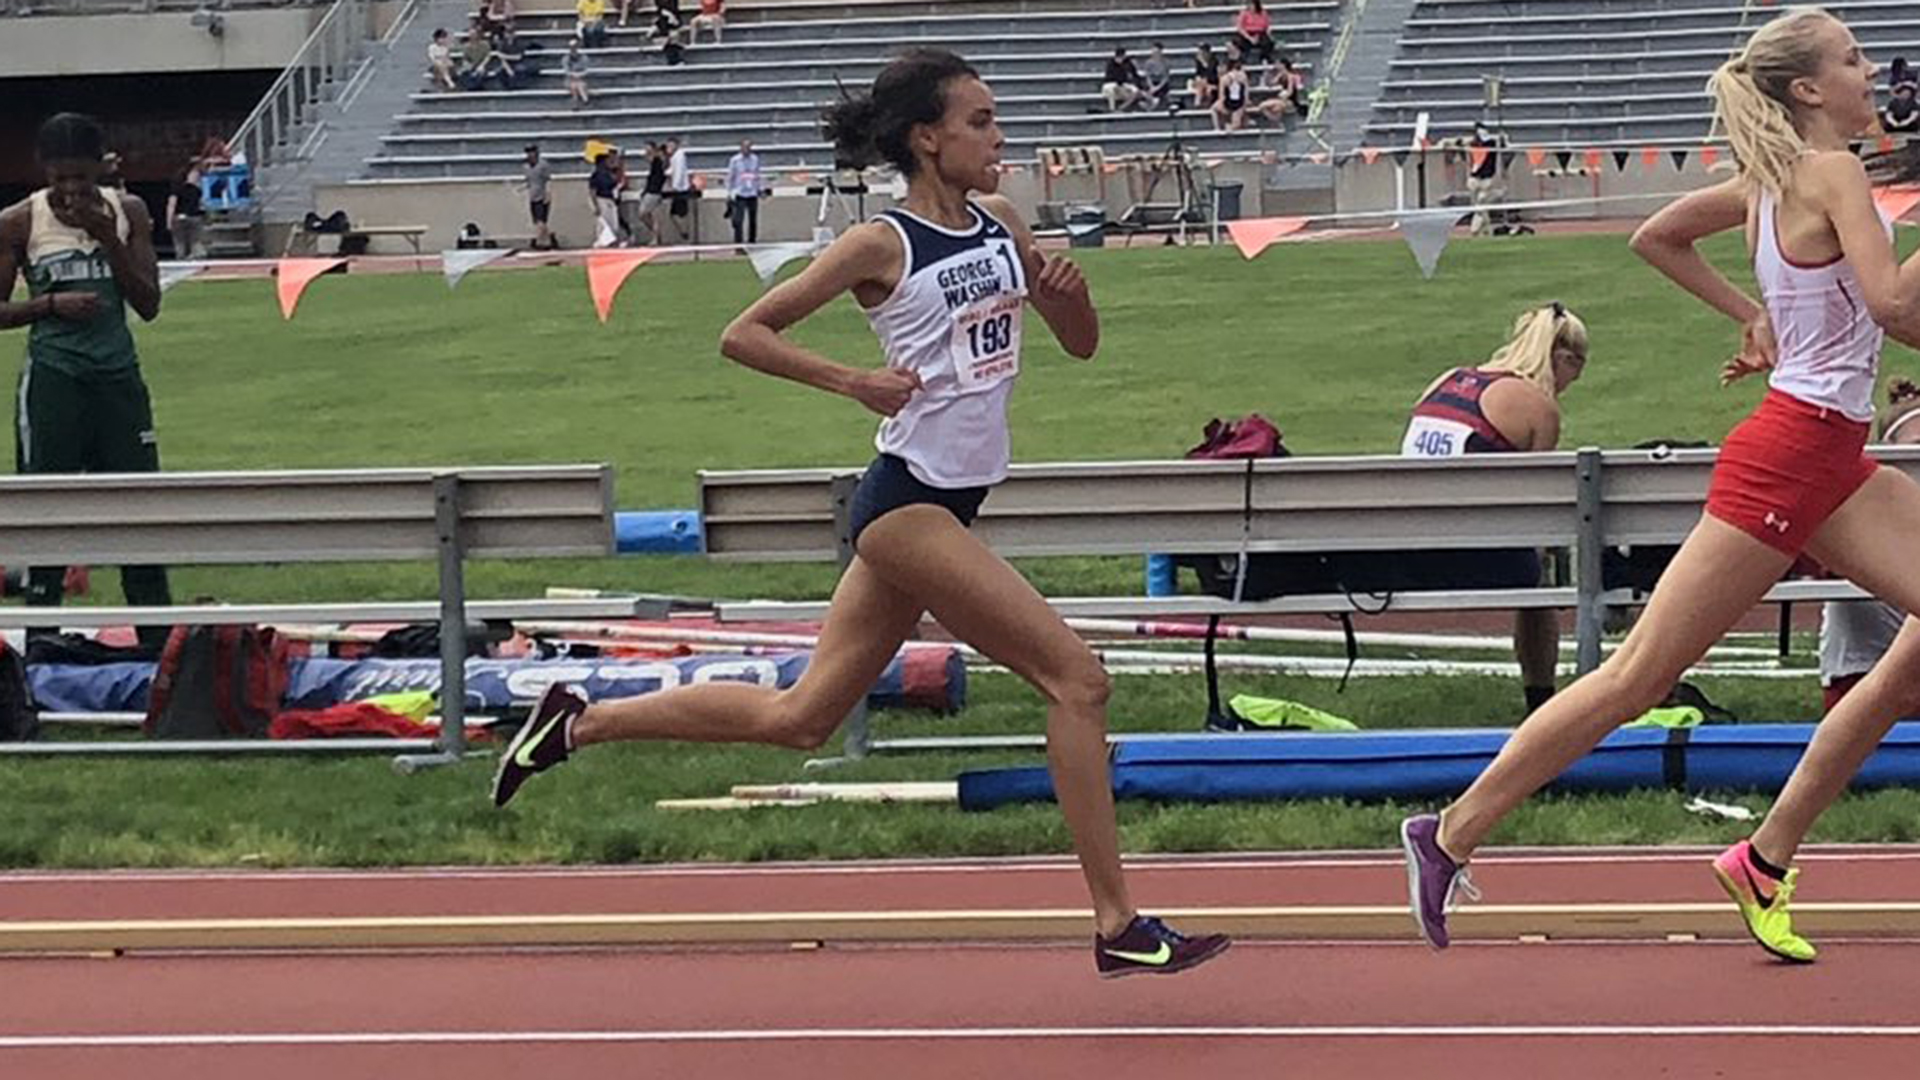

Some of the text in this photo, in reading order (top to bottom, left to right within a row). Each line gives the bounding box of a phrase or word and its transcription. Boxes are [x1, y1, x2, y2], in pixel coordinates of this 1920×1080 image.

[937, 257, 995, 289] GEORGE
[996, 243, 1018, 290] 1
[944, 275, 1001, 311] WASHIN
[966, 313, 1012, 358] 193
[1414, 430, 1453, 456] 405
